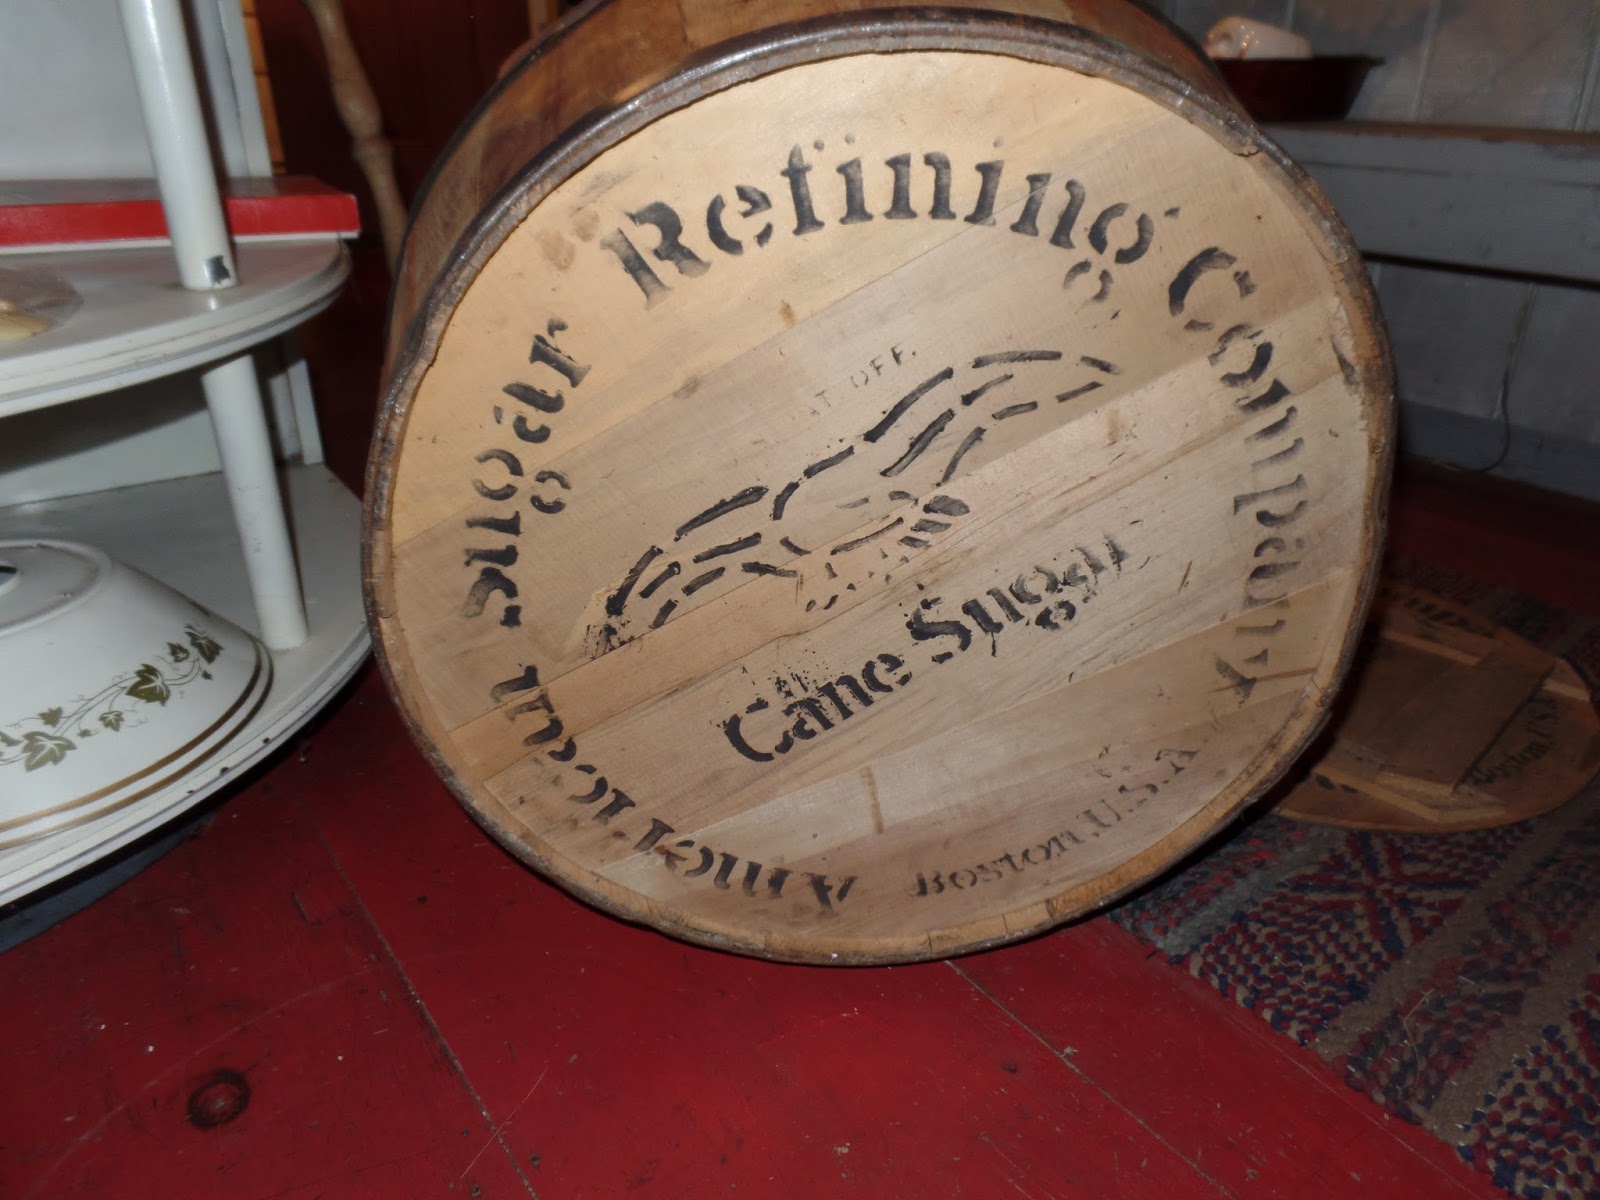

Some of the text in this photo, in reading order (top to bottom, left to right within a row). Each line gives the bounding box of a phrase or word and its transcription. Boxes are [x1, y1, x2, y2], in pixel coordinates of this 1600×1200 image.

[462, 131, 1307, 919] American Sugar Refining Company
[722, 536, 1130, 762] Cane Sugar
